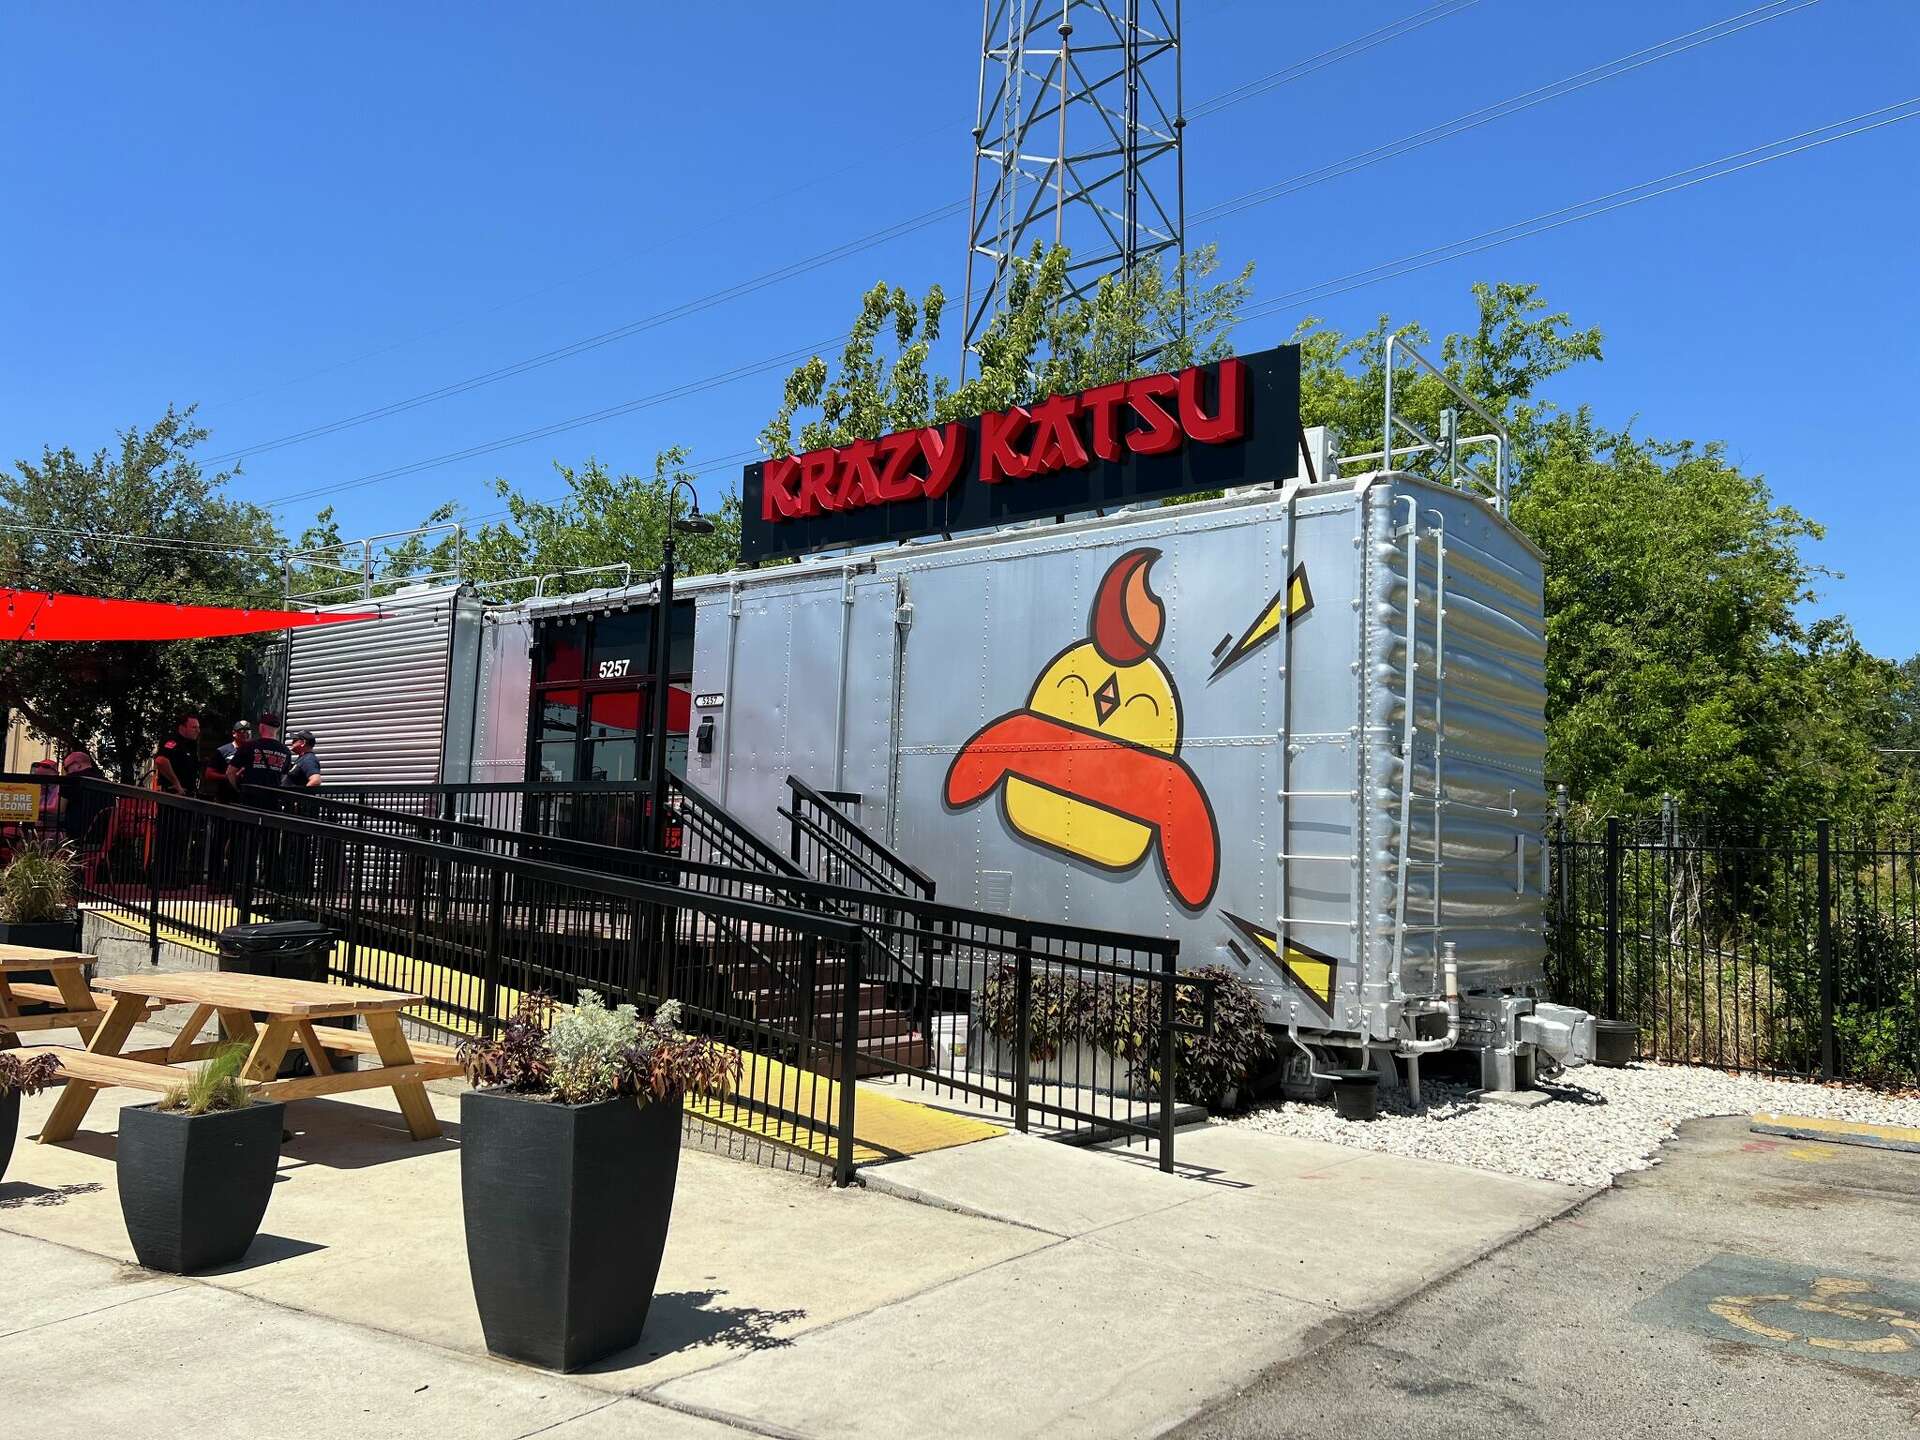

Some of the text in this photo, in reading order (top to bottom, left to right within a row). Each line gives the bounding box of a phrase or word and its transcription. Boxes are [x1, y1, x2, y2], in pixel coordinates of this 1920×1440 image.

[762, 357, 1247, 523] KRAZY KATSU
[599, 659, 630, 678] 5257
[702, 696, 718, 705] 5257
